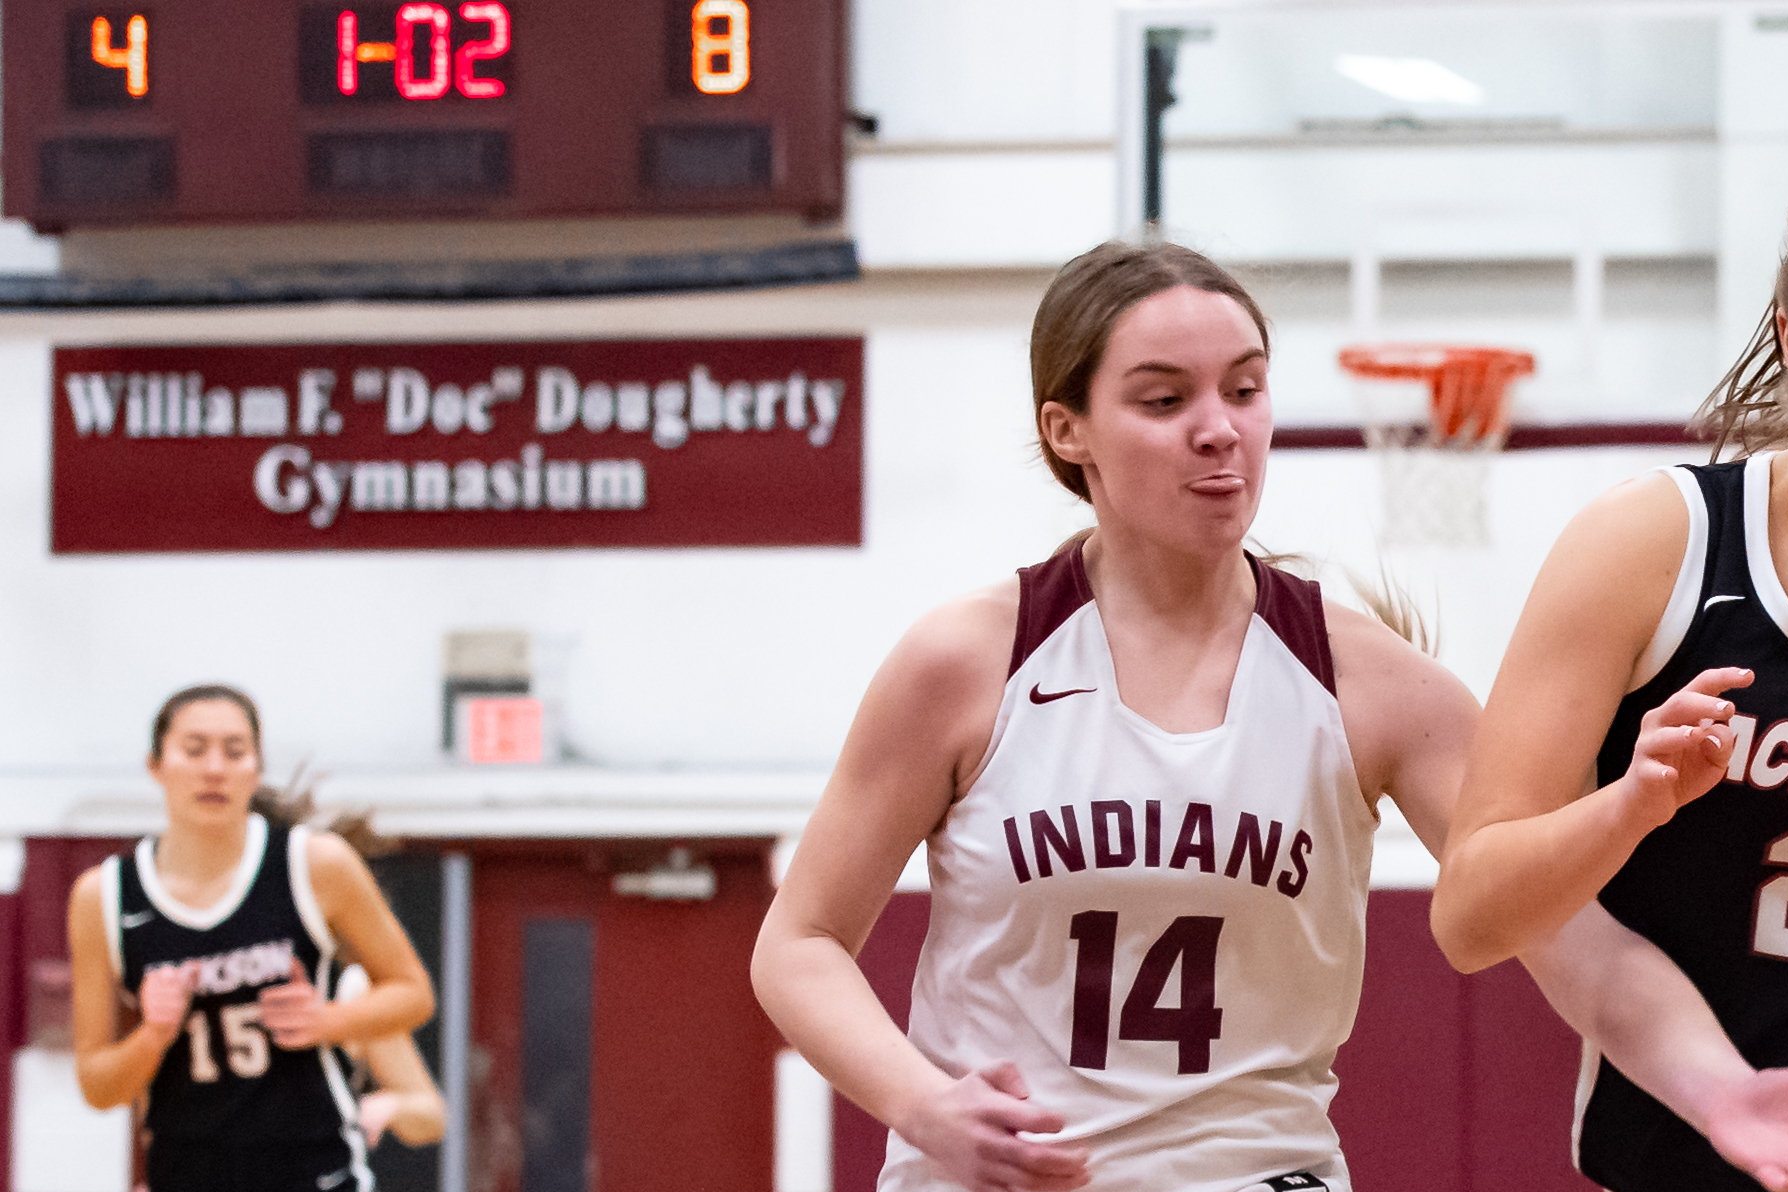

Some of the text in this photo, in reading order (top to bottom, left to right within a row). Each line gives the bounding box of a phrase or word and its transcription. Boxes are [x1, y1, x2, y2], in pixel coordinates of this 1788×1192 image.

[92, 15, 148, 97] 4
[692, 0, 750, 94] 8
[64, 364, 844, 450] William F. "Doc" Dougherty
[252, 443, 646, 529] Gymnasium
[1003, 799, 1312, 899] INDIANS
[1069, 909, 1225, 1075] 14
[186, 1002, 271, 1084] 15
